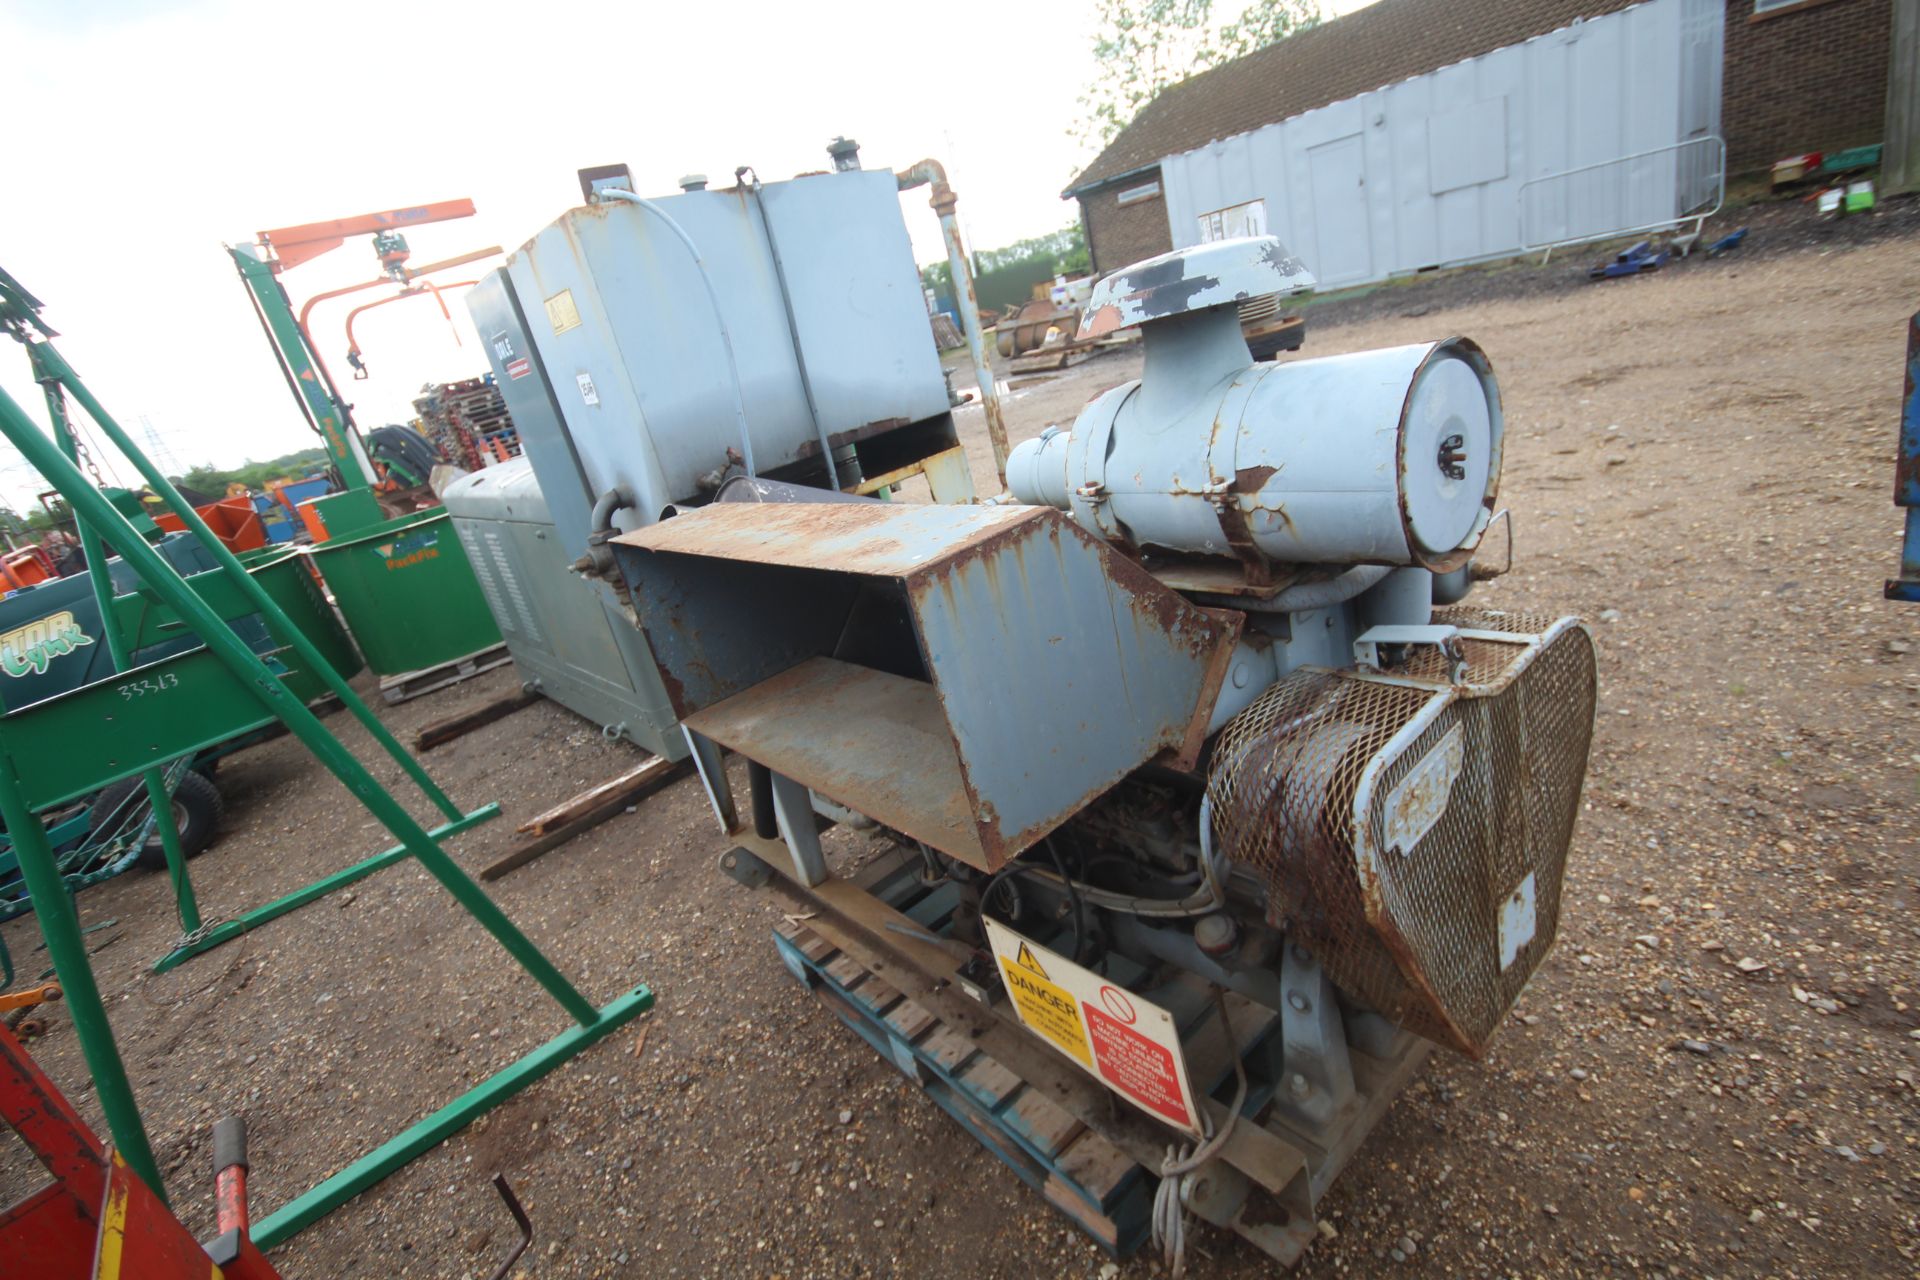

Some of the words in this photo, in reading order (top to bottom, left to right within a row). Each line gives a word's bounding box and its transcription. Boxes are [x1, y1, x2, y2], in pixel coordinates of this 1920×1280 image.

[1006, 969, 1079, 1021] DANGER
[1106, 1021, 1122, 1038] NOT
[1123, 1032, 1149, 1054] WORK
[1150, 1048, 1165, 1064] ON
